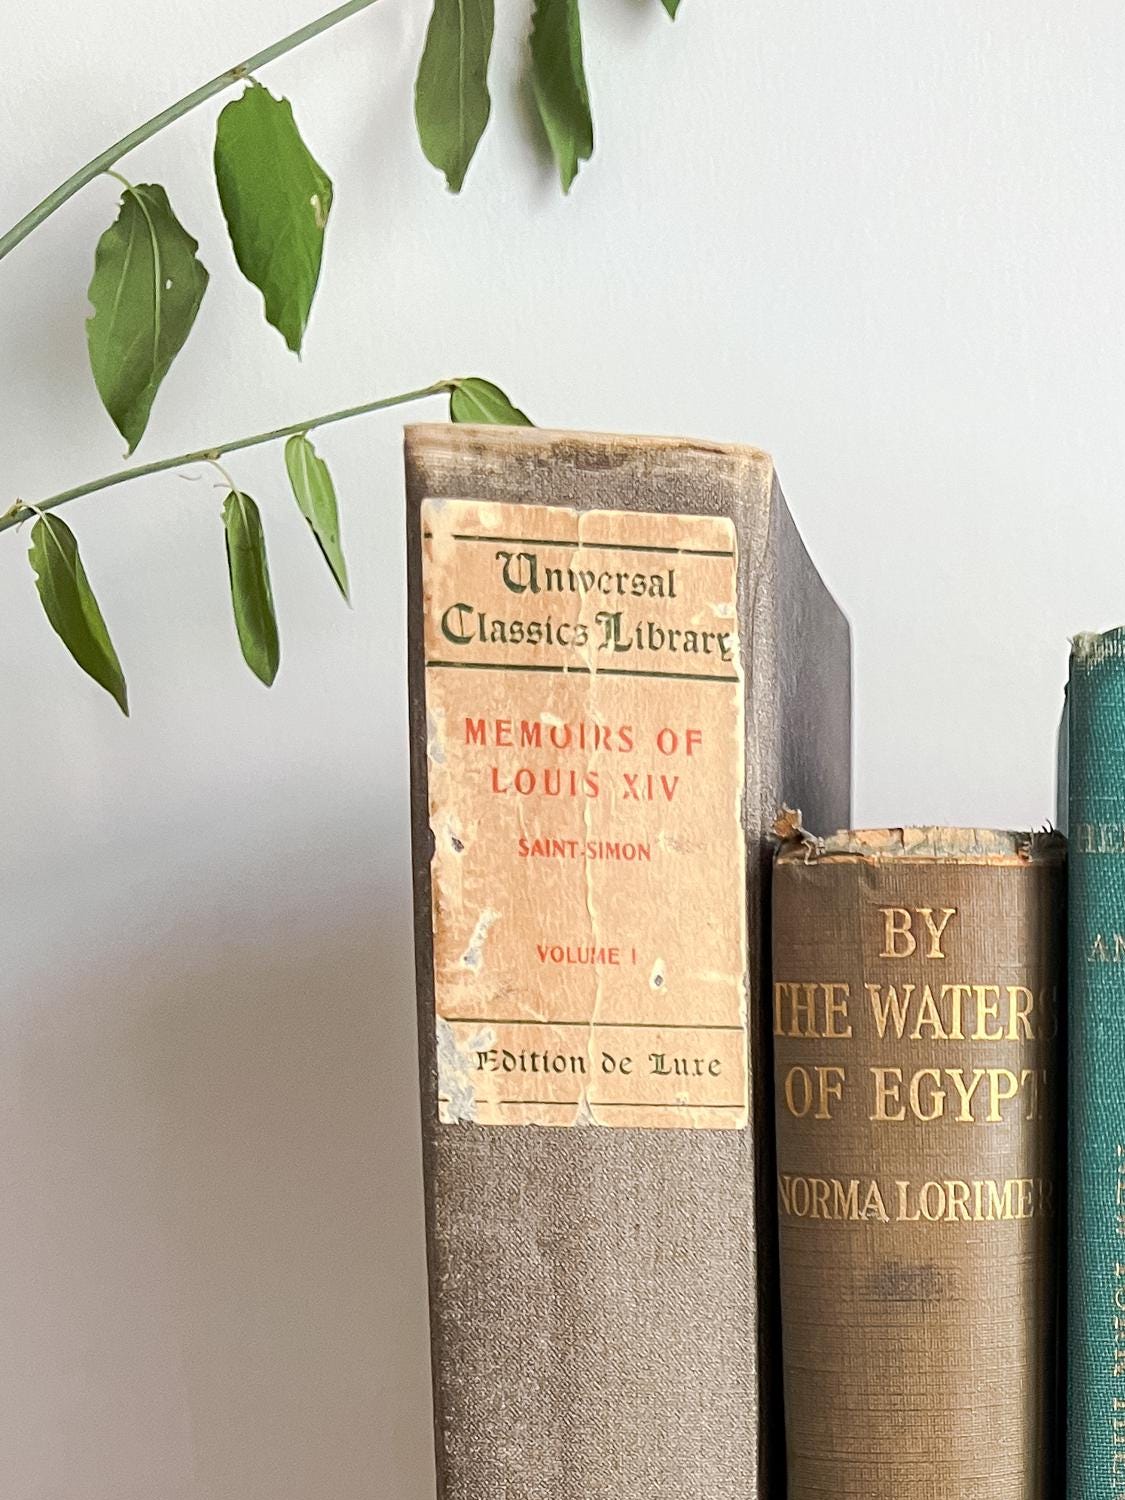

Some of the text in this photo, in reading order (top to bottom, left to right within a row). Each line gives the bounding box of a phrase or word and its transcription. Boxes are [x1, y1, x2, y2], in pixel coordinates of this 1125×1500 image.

[496, 551, 678, 599] Universal
[440, 602, 733, 662] Classics Library
[464, 717, 703, 757] MEMOIRS OF
[490, 767, 680, 802] LOUIS XIV
[535, 944, 621, 966] VOLUME
[878, 907, 958, 960] BY
[773, 981, 853, 1038] THE
[476, 1049, 588, 1076] Edition
[601, 1050, 633, 1075] de
[785, 1065, 1048, 1123] OF EGYPT
[778, 1174, 1050, 1224] NORMA LORIME
